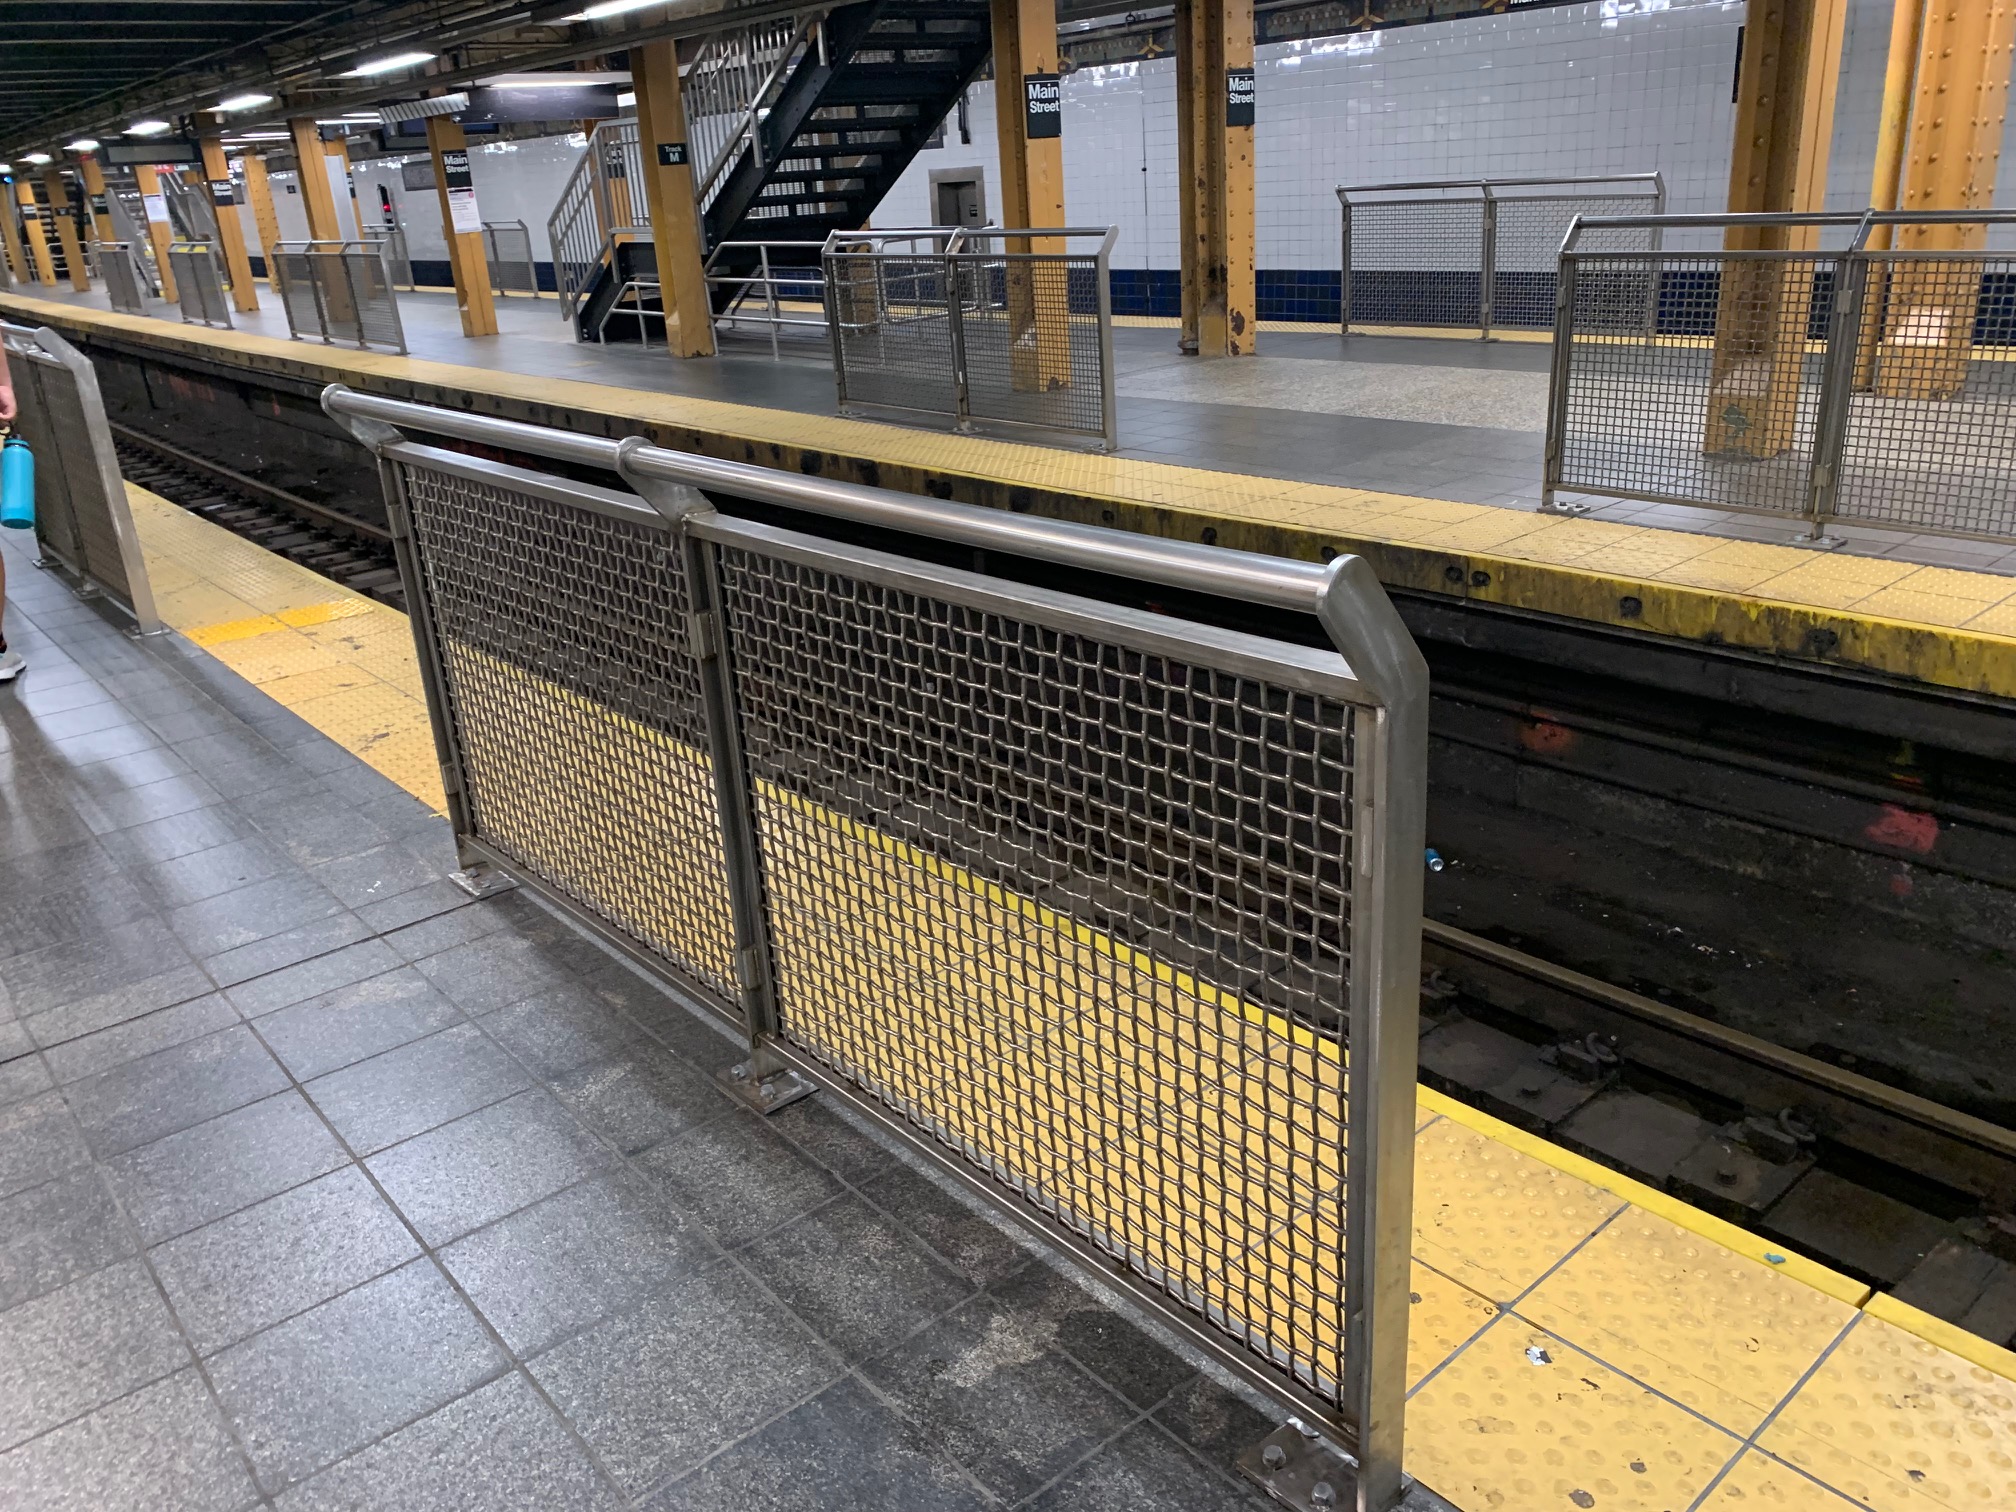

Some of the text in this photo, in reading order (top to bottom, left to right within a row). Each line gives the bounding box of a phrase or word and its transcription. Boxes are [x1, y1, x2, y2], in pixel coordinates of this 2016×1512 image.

[1228, 76, 1254, 91] Main
[1028, 83, 1059, 99] Main
[1229, 92, 1254, 104] Street
[1029, 100, 1060, 114] Street
[443, 155, 468, 165] Main
[669, 152, 680, 162] M
[445, 164, 469, 173] Street
